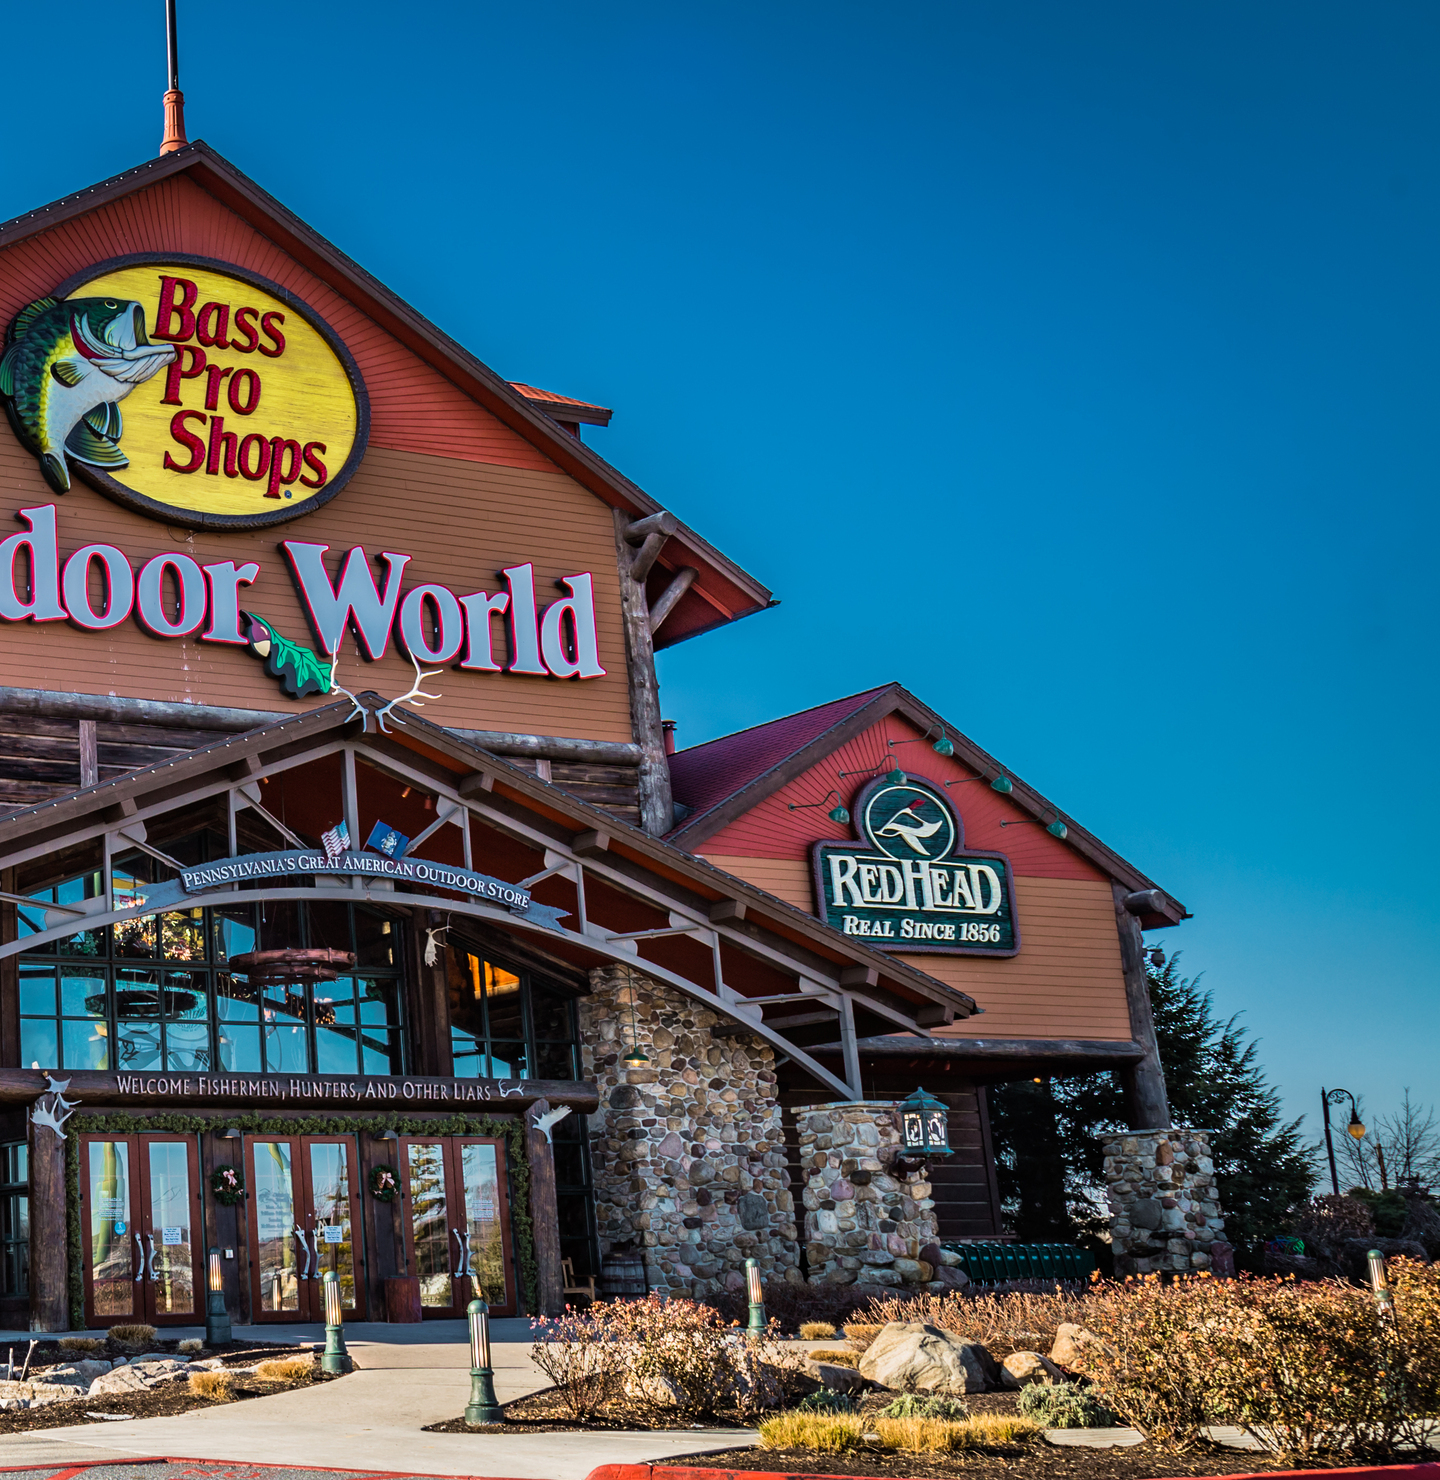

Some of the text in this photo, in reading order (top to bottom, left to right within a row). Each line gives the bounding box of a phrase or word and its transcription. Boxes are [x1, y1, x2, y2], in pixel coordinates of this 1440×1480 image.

[150, 275, 286, 357] Bass
[160, 344, 262, 414] Pro
[164, 410, 327, 498] Shops
[279, 540, 607, 680] World
[182, 855, 530, 909] PENNSYLVANIA'S GREAT AMERICAN OUTDOOR STORE
[842, 915, 1001, 943] REAL SINCE 1856
[116, 1075, 191, 1095] WELCOME
[364, 1080, 398, 1099] AND
[402, 1081, 449, 1100] OTHER
[453, 1082, 492, 1101] LIARS
